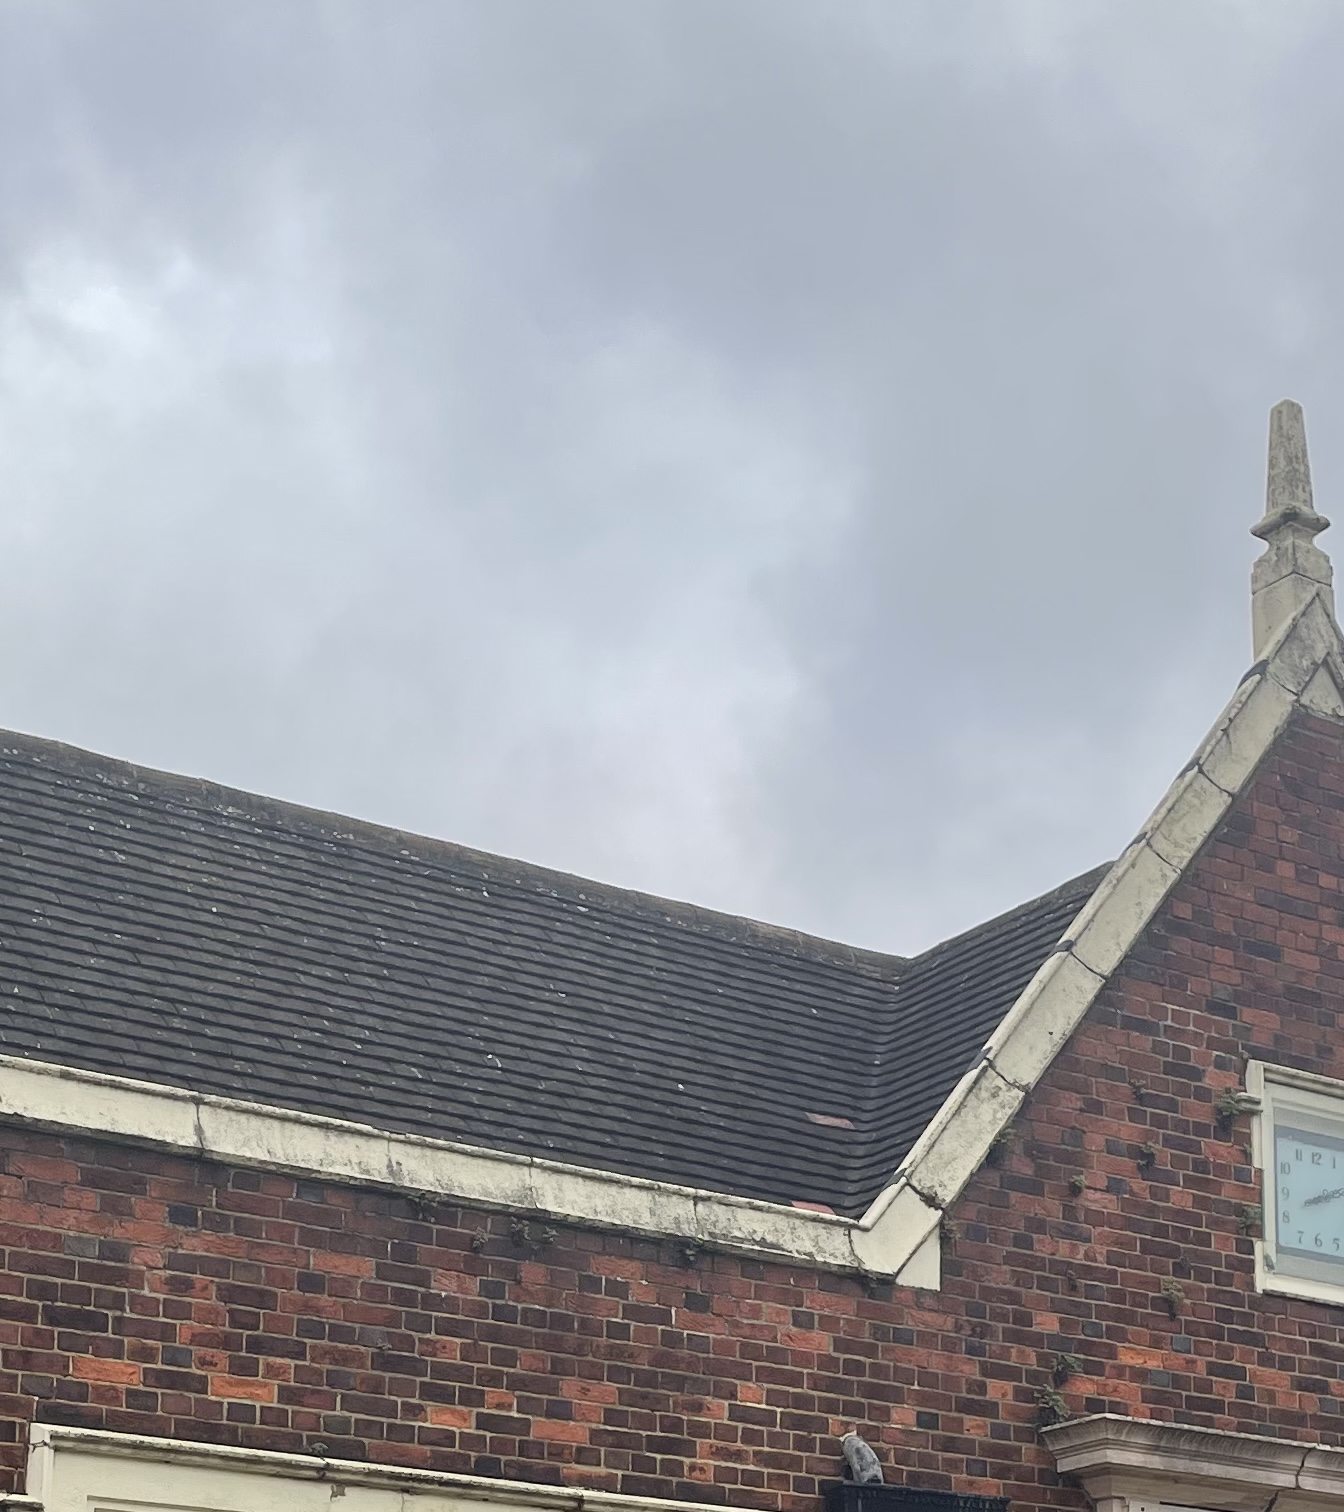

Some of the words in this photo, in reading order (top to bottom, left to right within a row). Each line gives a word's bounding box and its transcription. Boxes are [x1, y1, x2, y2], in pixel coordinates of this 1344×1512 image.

[1295, 1148, 1303, 1162] 11
[1311, 1152, 1322, 1166] 12
[1280, 1161, 1291, 1175] 10
[1332, 1157, 1336, 1169] 1
[1281, 1186, 1290, 1201] 9
[1282, 1210, 1290, 1224] 8
[1297, 1230, 1305, 1244] 7
[1314, 1232, 1323, 1248] 6
[1332, 1237, 1341, 1251] 5
